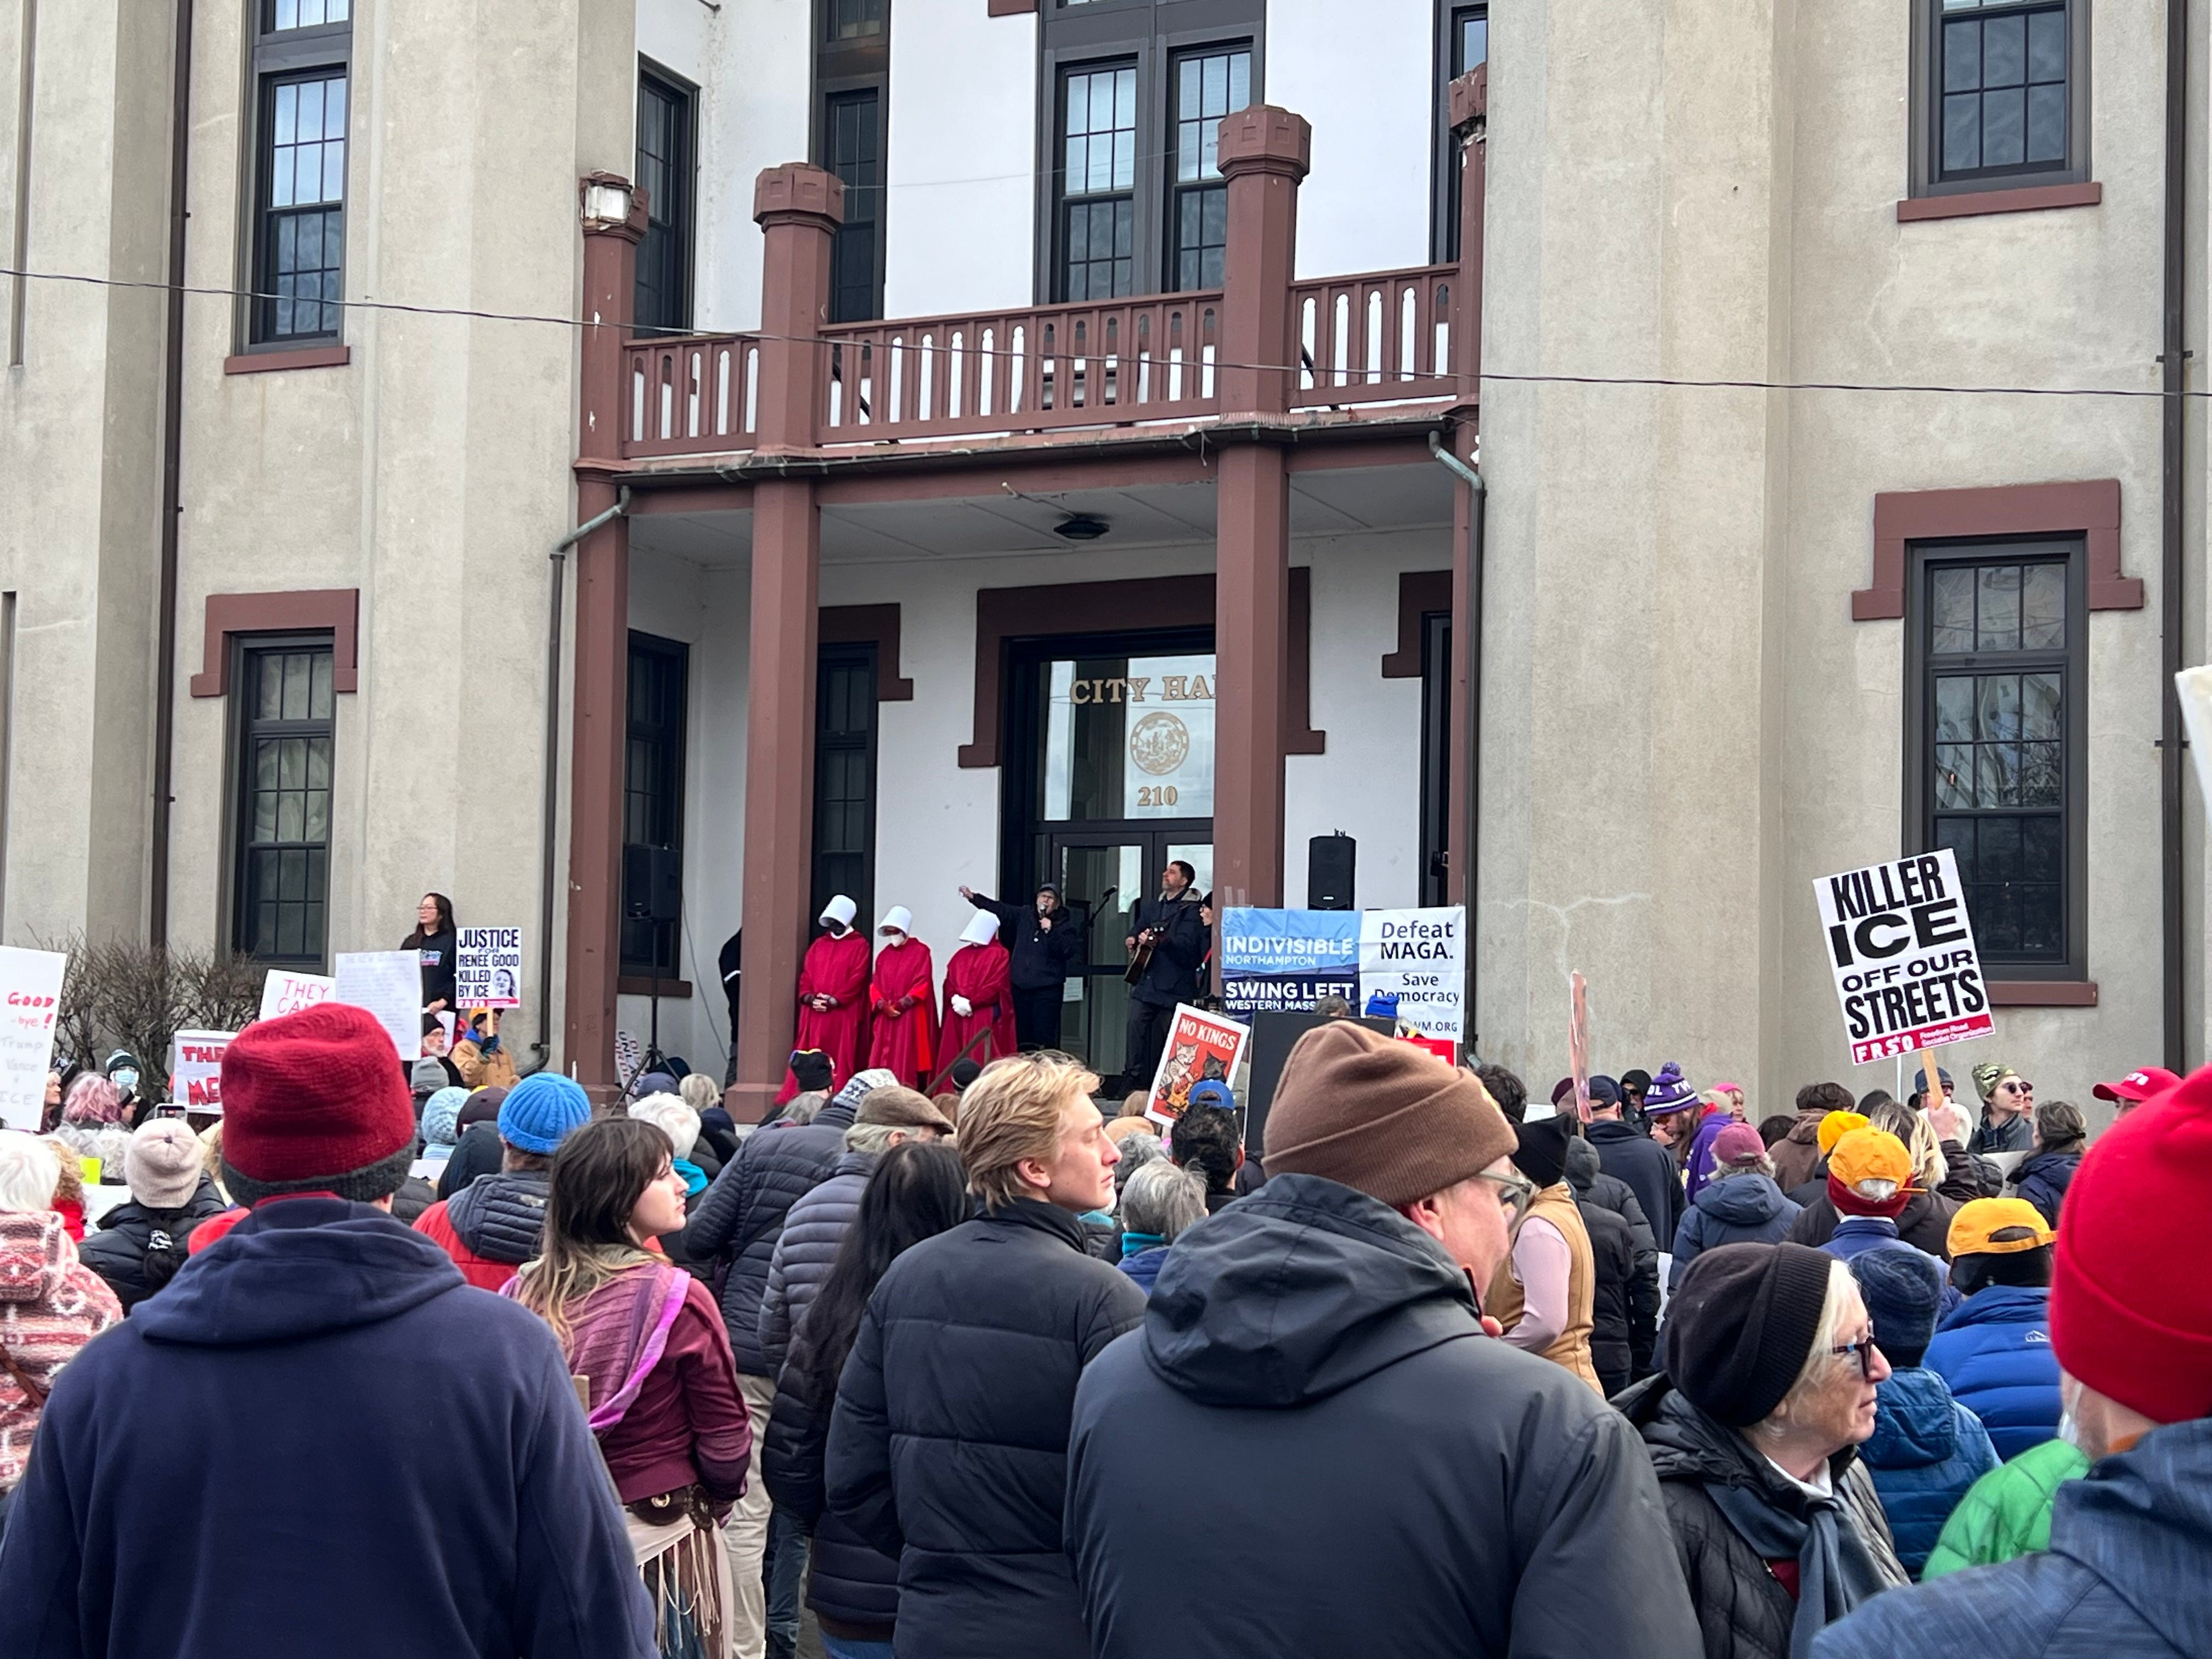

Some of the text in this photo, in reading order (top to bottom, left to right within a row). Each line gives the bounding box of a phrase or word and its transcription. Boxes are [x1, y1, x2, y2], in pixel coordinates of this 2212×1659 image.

[1069, 674, 1216, 704] CITY HA
[1137, 786, 1178, 806] 210
[1830, 855, 1946, 922] KILLER
[459, 929, 519, 948] JUSTICE
[1381, 920, 1454, 939] Defeat
[1829, 898, 1967, 968] ICE
[1226, 935, 1353, 955] INDIVISIBLE
[1380, 941, 1454, 960] MAGA.
[459, 954, 519, 967] RENEE GOOD
[1225, 955, 1316, 966] NORTHAMPTON
[459, 969, 491, 983] KILLED
[1402, 973, 1439, 986] Save
[1842, 949, 1974, 992] OFF OUR
[283, 979, 330, 1000] THEY
[459, 985, 489, 997] BY ICE
[1225, 981, 1355, 1000] SWING LEFT
[8, 992, 54, 1008] GOOD
[277, 997, 309, 1014] CA
[1225, 1000, 1316, 1011] WESTERN MASS
[1844, 969, 1985, 1039] STREETS
[1178, 1018, 1238, 1051] NO KINGS
[0, 1036, 43, 1053] Trump
[5, 1059, 38, 1071] Vance
